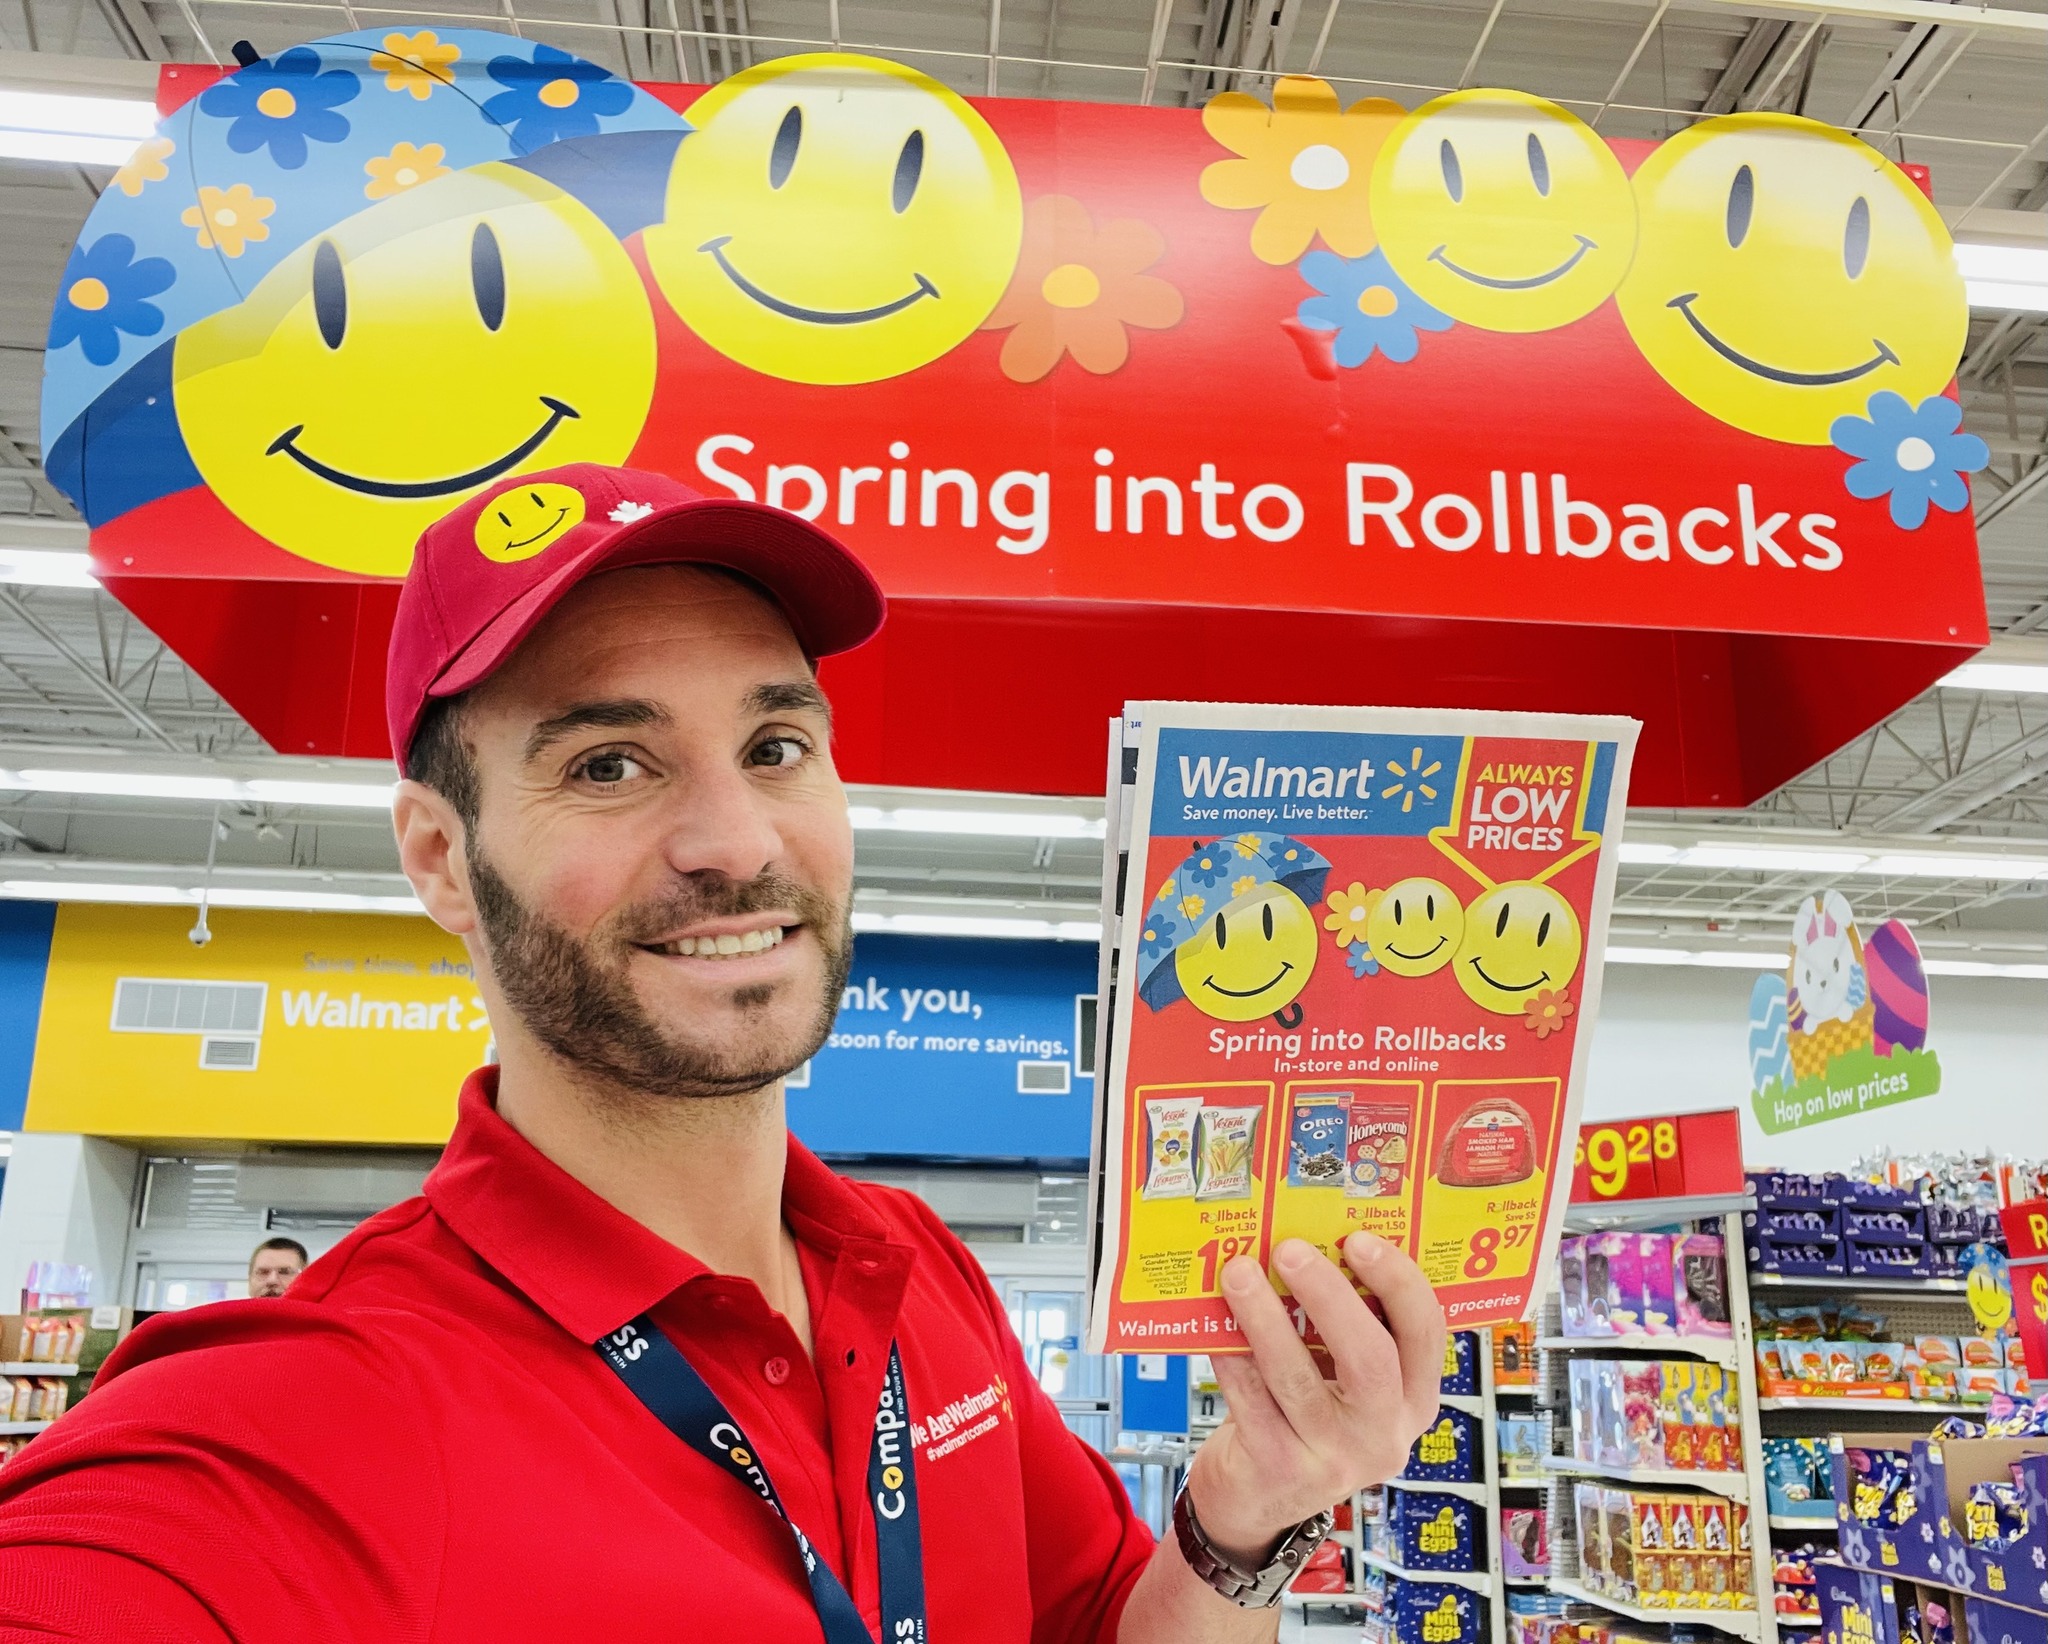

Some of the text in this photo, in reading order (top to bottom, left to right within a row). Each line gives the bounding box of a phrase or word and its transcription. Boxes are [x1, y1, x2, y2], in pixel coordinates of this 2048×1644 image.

[695, 434, 1844, 571] Spring into Rollbacks
[1178, 755, 1375, 799] Walmart
[1477, 763, 1575, 786] ALWAYS
[1183, 804, 1368, 823] Save money. Live better.
[1470, 785, 1571, 825] LOW
[1467, 825, 1564, 851] PRICES
[303, 952, 356, 973] Save
[281, 989, 463, 1031] Walmart
[901, 987, 983, 1022] you,
[828, 1030, 1068, 1059] soon for more savings.
[1209, 1026, 1506, 1059] Spring into Rollbacks
[1274, 1056, 1439, 1073] In-store and online
[1773, 1071, 1909, 1126] Hop on low prices
[1300, 1117, 1344, 1132] OREO
[1348, 1121, 1408, 1145] Honeycomb
[1361, 1221, 1406, 1231] Save 1.50
[1505, 1211, 1536, 1222] Save $5
[1214, 1222, 1257, 1234] Save 1.30
[1118, 1318, 1198, 1336] Walmart
[1204, 1316, 1218, 1332] is
[1449, 1293, 1521, 1317] groceries
[610, 1350, 627, 1369] PATH
[875, 1373, 906, 1519] Compa
[926, 1414, 1000, 1461] #walmartcanada
[1421, 1432, 1455, 1448] Mini
[1419, 1447, 1457, 1464] Eggs
[1420, 1521, 1456, 1537] Mini
[1419, 1536, 1458, 1553] Eggs
[916, 1618, 924, 1640] PATH
[1423, 1610, 1459, 1627] Mini
[1422, 1625, 1462, 1642] Eggs
